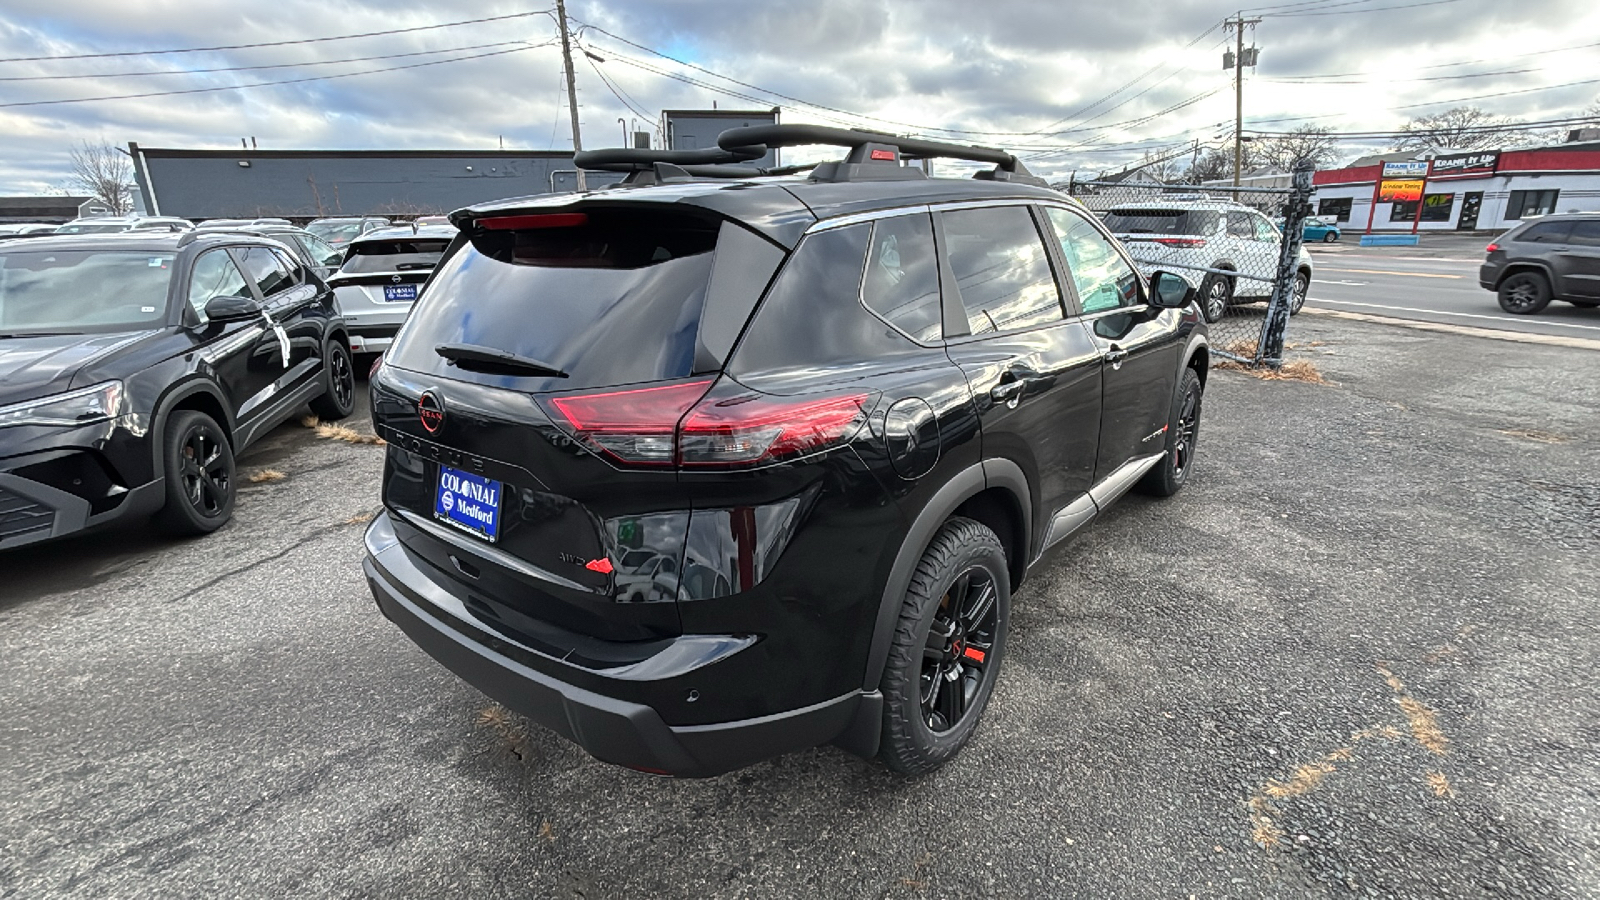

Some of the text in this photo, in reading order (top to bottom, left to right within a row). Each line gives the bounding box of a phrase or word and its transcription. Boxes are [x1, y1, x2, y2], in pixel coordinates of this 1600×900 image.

[441, 472, 498, 508] COLONIAL
[456, 498, 494, 525] Medford
[559, 551, 586, 566] AWD
